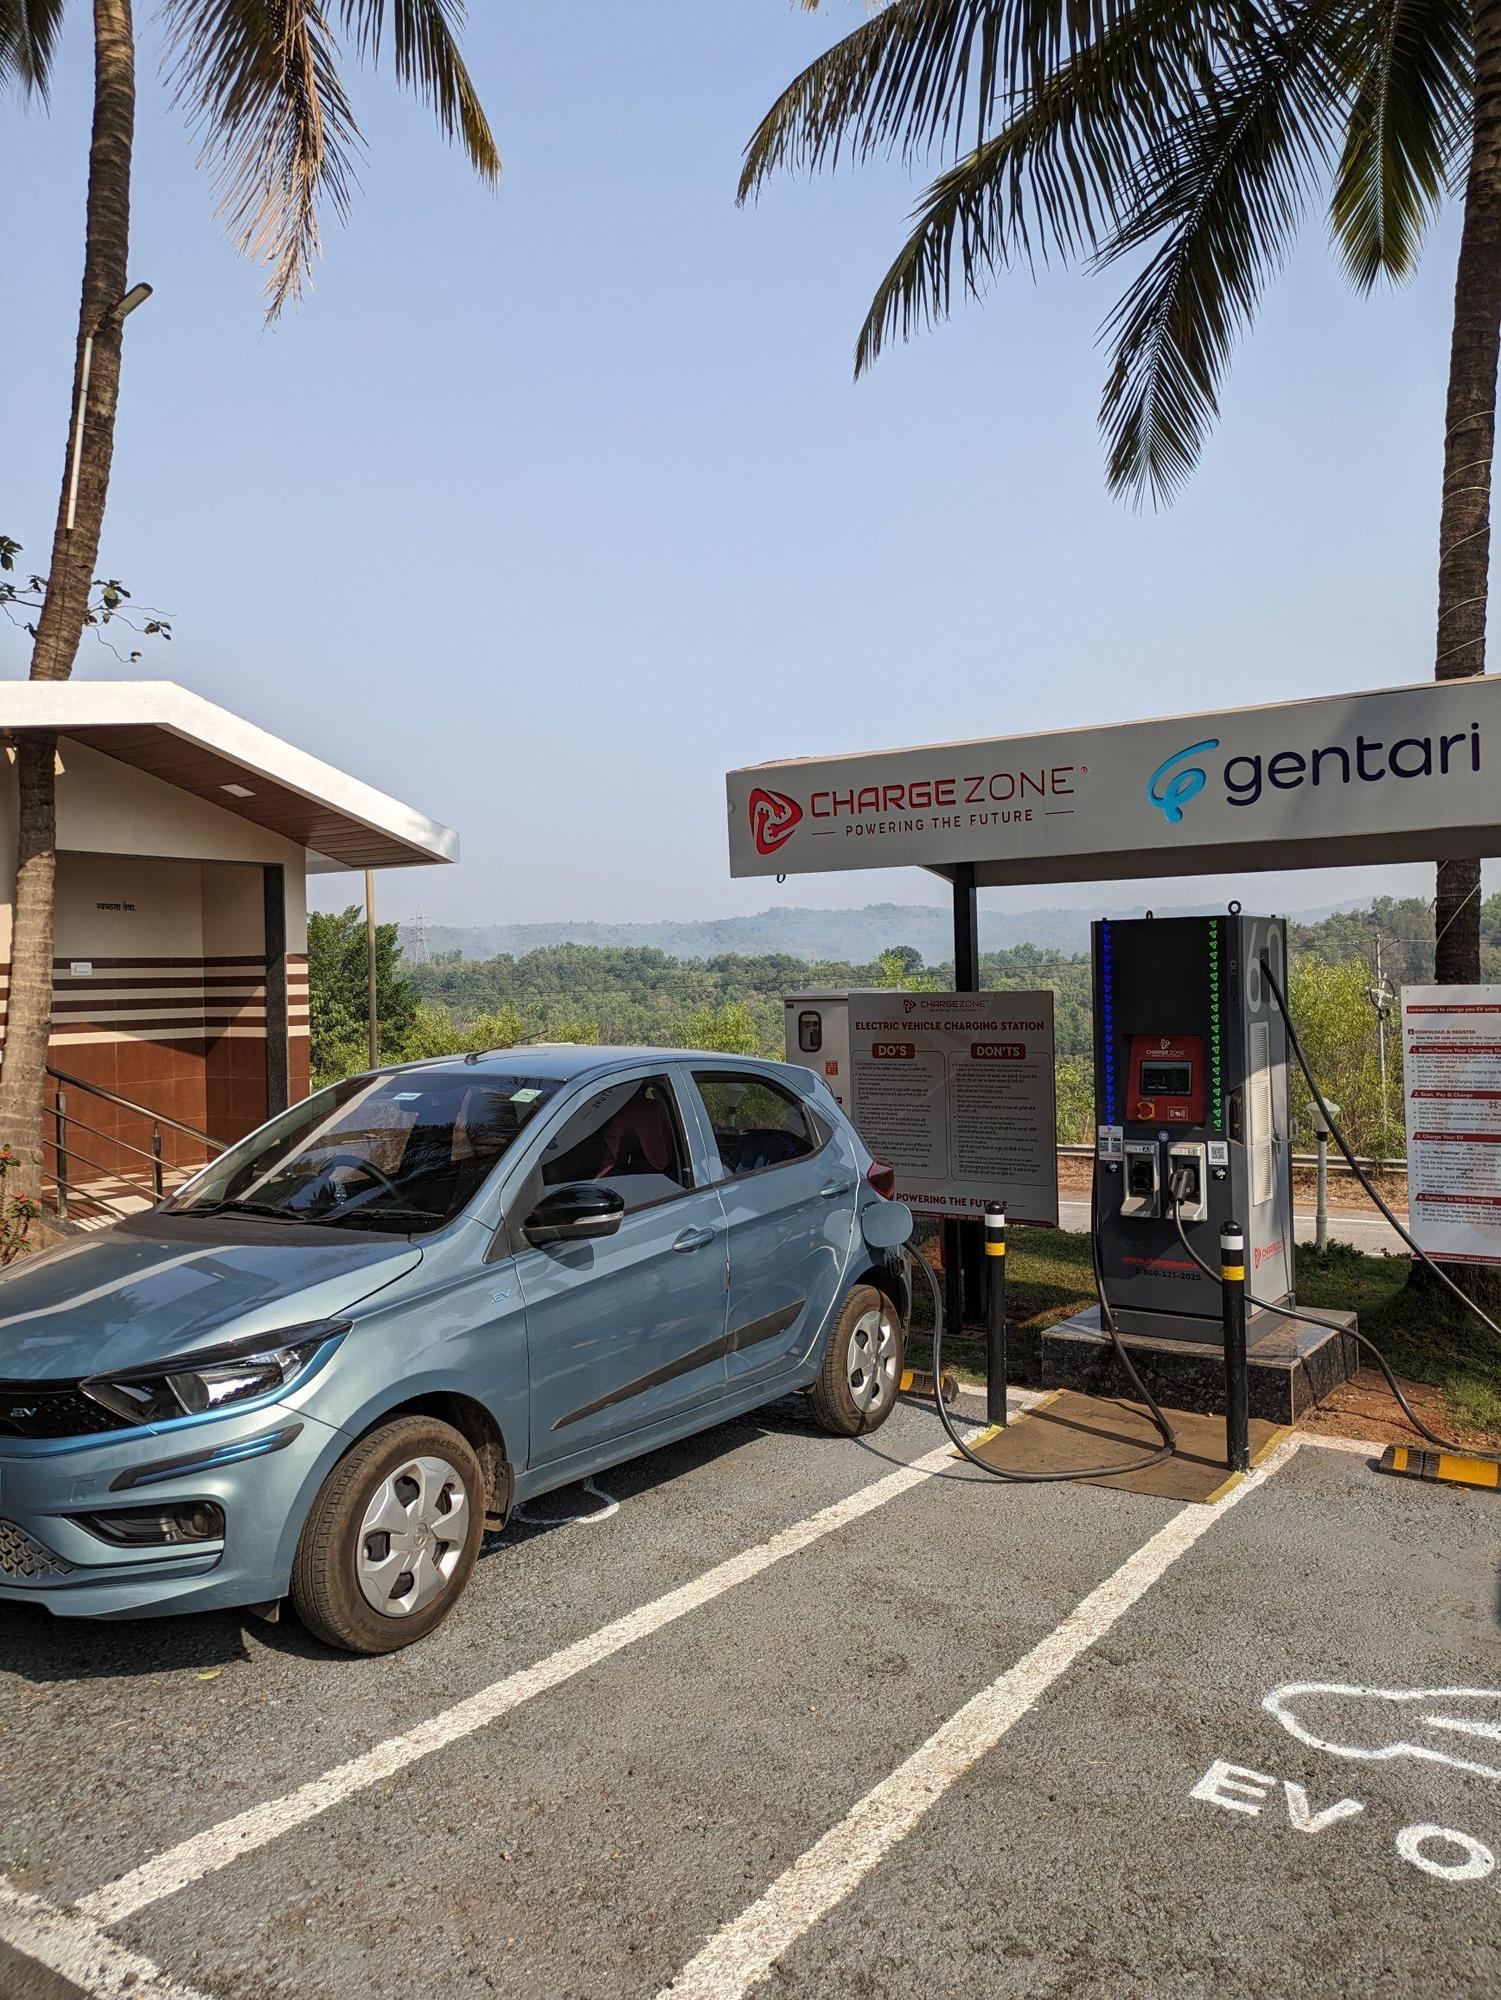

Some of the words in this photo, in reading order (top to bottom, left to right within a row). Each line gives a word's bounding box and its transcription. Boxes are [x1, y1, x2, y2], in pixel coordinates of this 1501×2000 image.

[1224, 722, 1480, 806] gentari
[845, 819, 924, 836] POWERING
[932, 815, 961, 830] THE
[970, 809, 1033, 827] FUTURE
[855, 1021, 900, 1031] ELECTRIC
[901, 1021, 942, 1031] VEHICLE
[943, 1021, 998, 1031] CHARGING
[1000, 1021, 1045, 1031] STATION
[878, 1045, 907, 1056] DO'S
[976, 1046, 1020, 1057] DON'TS
[896, 1192, 947, 1205] POWERING
[948, 1197, 967, 1207] THE
[970, 1199, 1008, 1210] FUTE
[1190, 1758, 1365, 1833] EV
